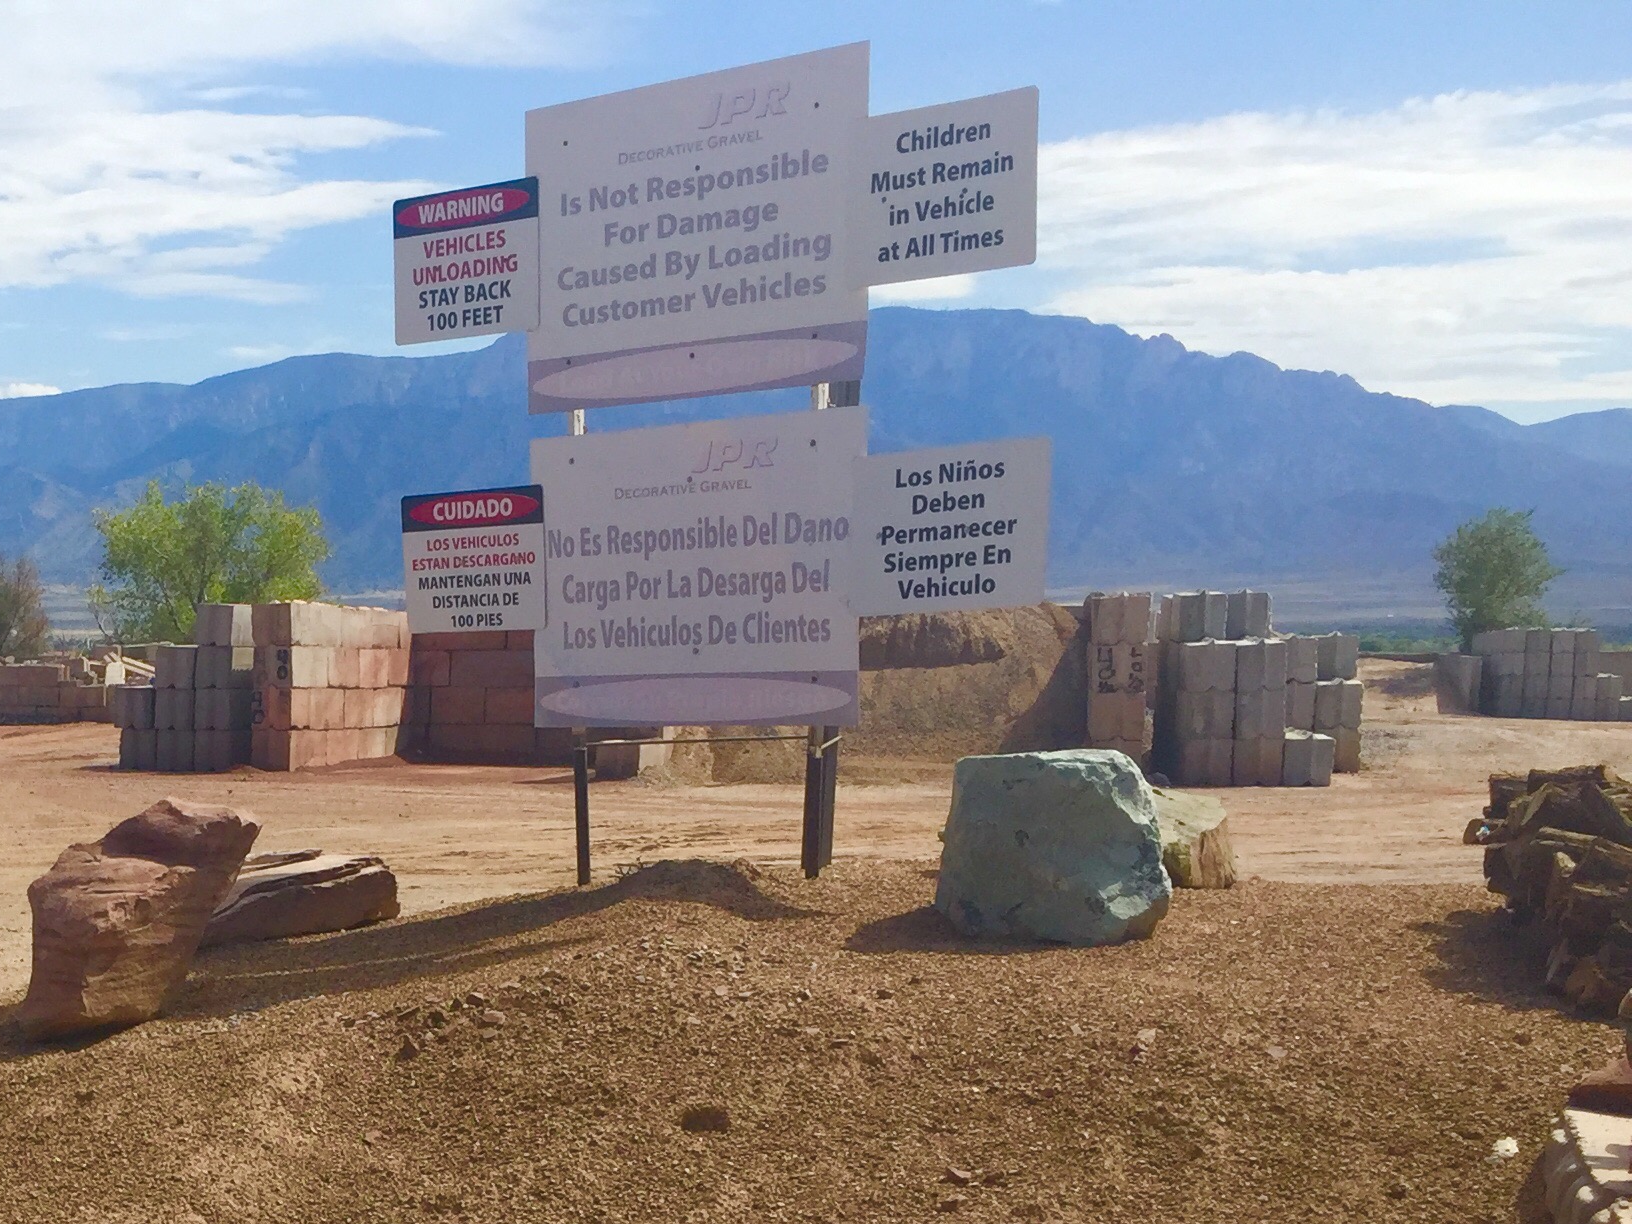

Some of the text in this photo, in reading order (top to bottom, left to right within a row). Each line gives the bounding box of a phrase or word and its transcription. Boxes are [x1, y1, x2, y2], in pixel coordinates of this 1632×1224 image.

[896, 122, 991, 153] Children
[560, 149, 829, 216] Is Not Responsible
[870, 151, 1014, 194] Must Remain
[418, 193, 504, 224] WARNING
[889, 190, 995, 226] in Vehicle
[604, 202, 779, 247] For Damage
[423, 229, 506, 259] VEHICLES
[878, 229, 1004, 263] at All Times
[413, 254, 518, 286] UNLOADING
[558, 232, 832, 291] Caused By Loading
[419, 279, 511, 309] STAY BACK
[563, 272, 827, 327] Customer Vehicles
[427, 305, 504, 331] 100 FEET
[895, 460, 1005, 488] Los Niños
[433, 497, 513, 521] CUIDADO
[912, 490, 985, 515] Deben
[426, 533, 519, 552] LOS VEHICULOS
[548, 512, 850, 561] No Es Responsible Del Dano
[881, 518, 1018, 546] Permanecer
[412, 551, 536, 571] ESTAN DESCARGANO
[883, 544, 1011, 574] Siempre En
[418, 571, 531, 590] MANTENGAN UNA
[562, 559, 830, 610] Carga Por La Desarga Del
[898, 573, 996, 600] Vehiculo
[432, 592, 519, 609] DISTANCIA DE
[451, 613, 503, 628] 100 PIES
[563, 611, 831, 650] Los Vehiculos De Clientes
